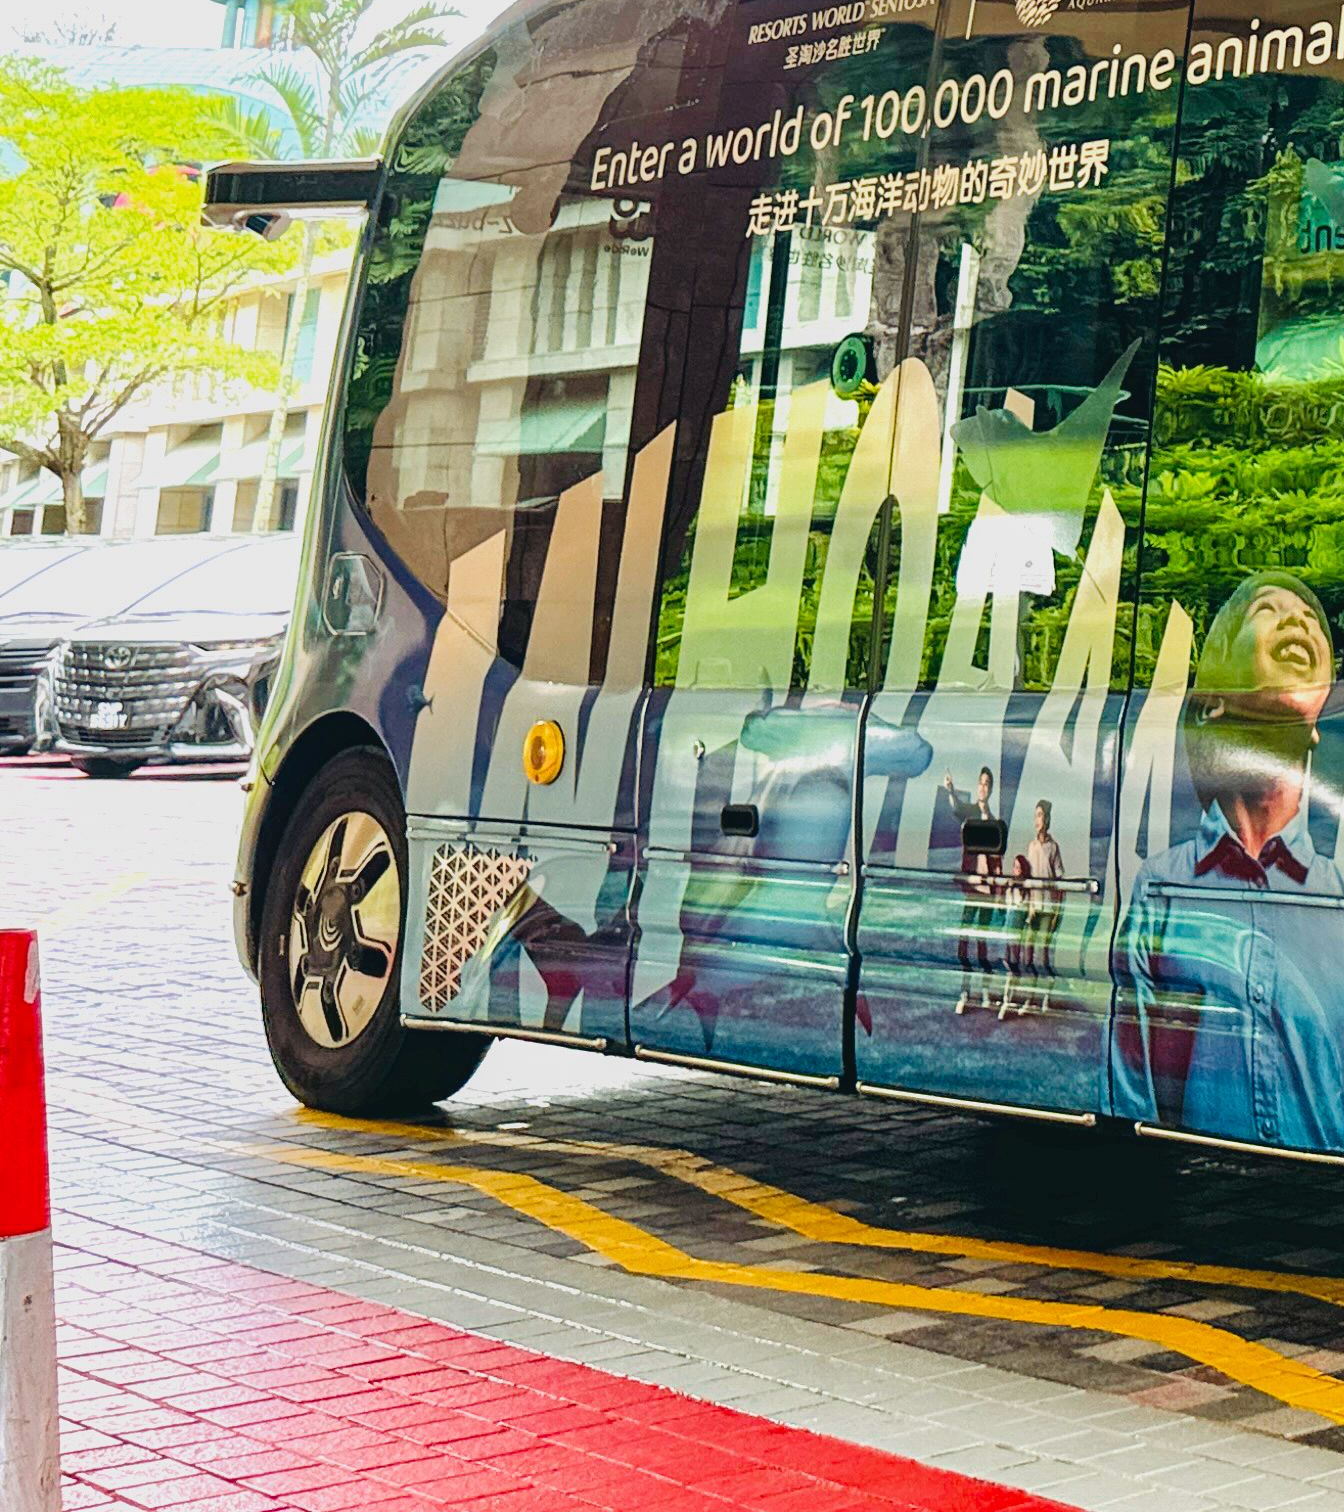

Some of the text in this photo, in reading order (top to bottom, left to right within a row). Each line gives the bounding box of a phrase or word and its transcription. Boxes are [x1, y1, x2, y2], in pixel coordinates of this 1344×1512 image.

[748, 13, 807, 45] RESORTS
[591, 140, 673, 191] Enter
[679, 136, 698, 175] a
[706, 105, 804, 169] world
[811, 94, 856, 150] of
[861, 68, 1014, 140] 100,000
[1023, 43, 1176, 113] marine
[745, 139, 1110, 239] 走进十万海洋动物的奇妙世界
